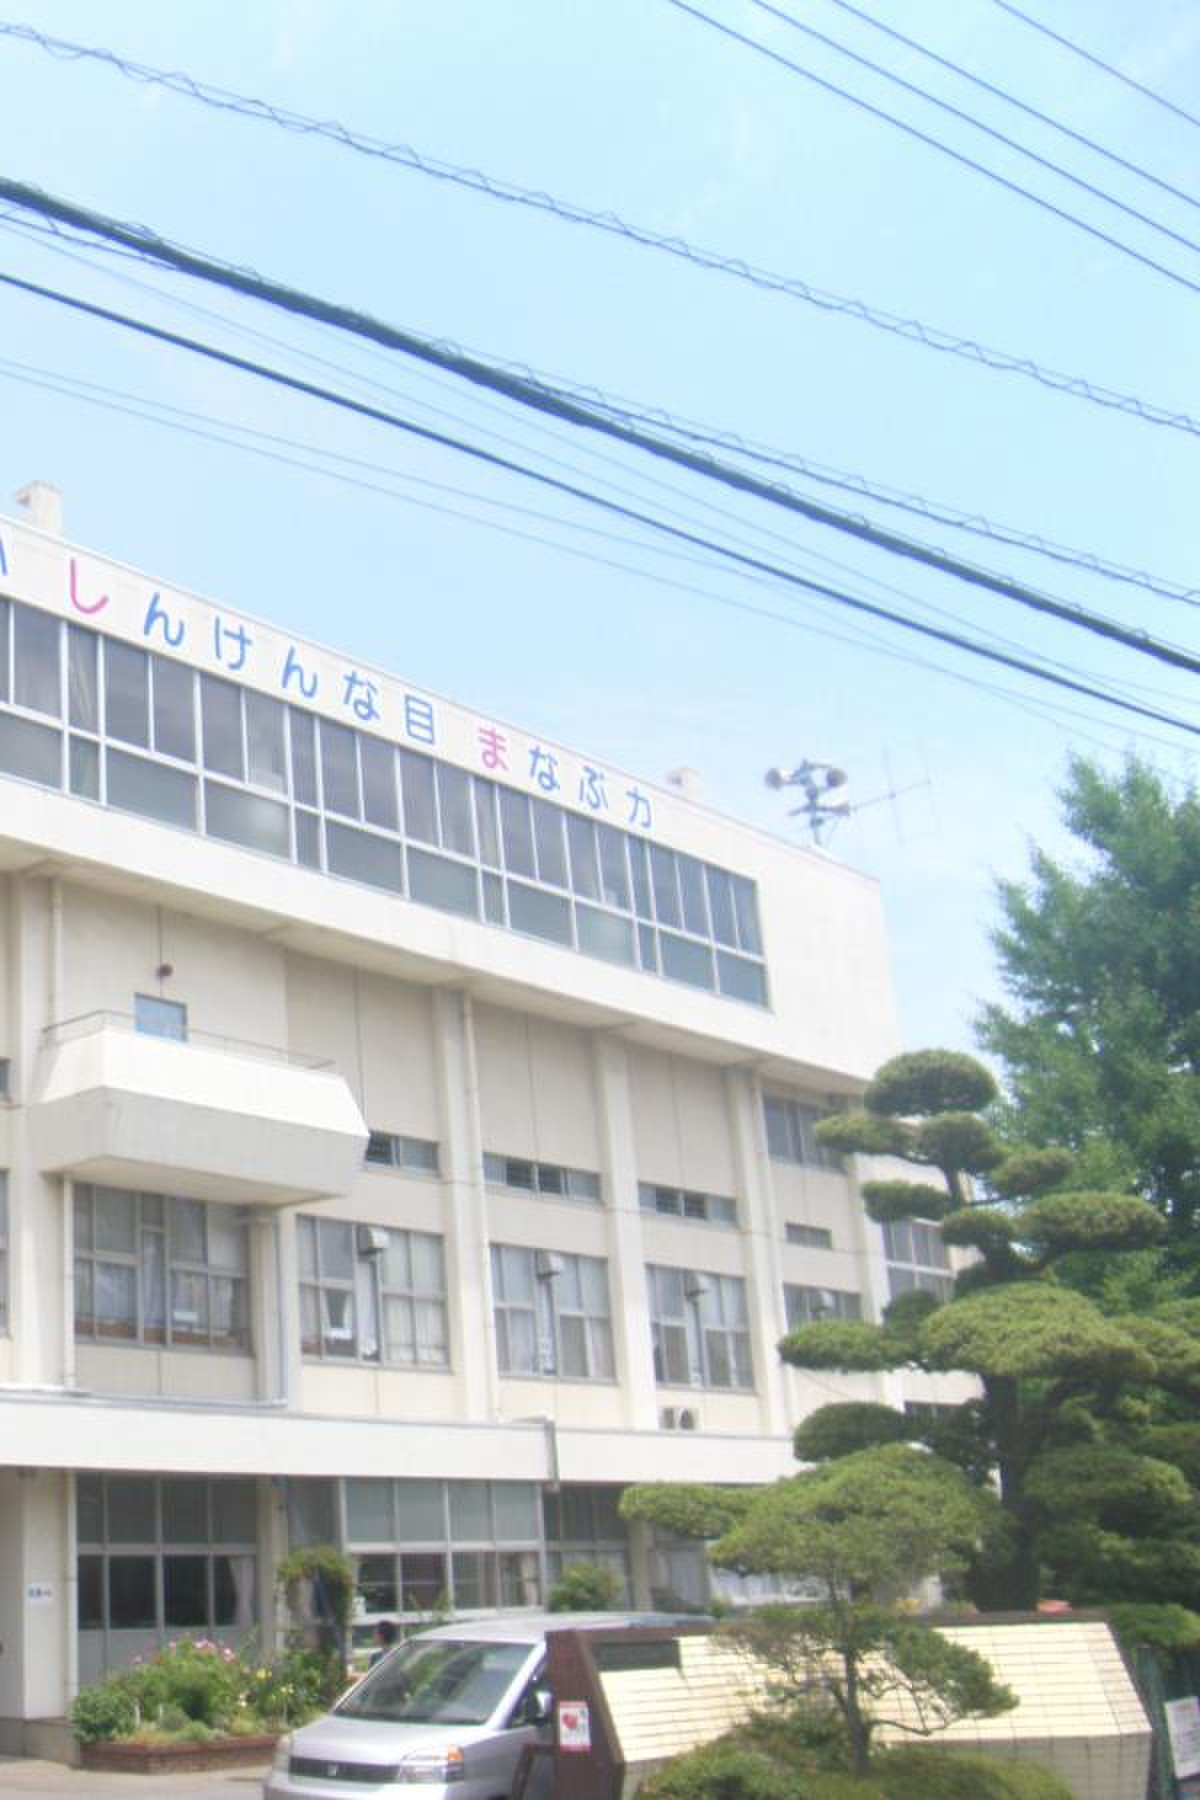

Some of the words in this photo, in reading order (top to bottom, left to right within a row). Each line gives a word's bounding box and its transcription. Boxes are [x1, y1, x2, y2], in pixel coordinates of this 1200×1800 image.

[68, 558, 436, 745] しんけんな目
[477, 726, 653, 830] まなぶ力
